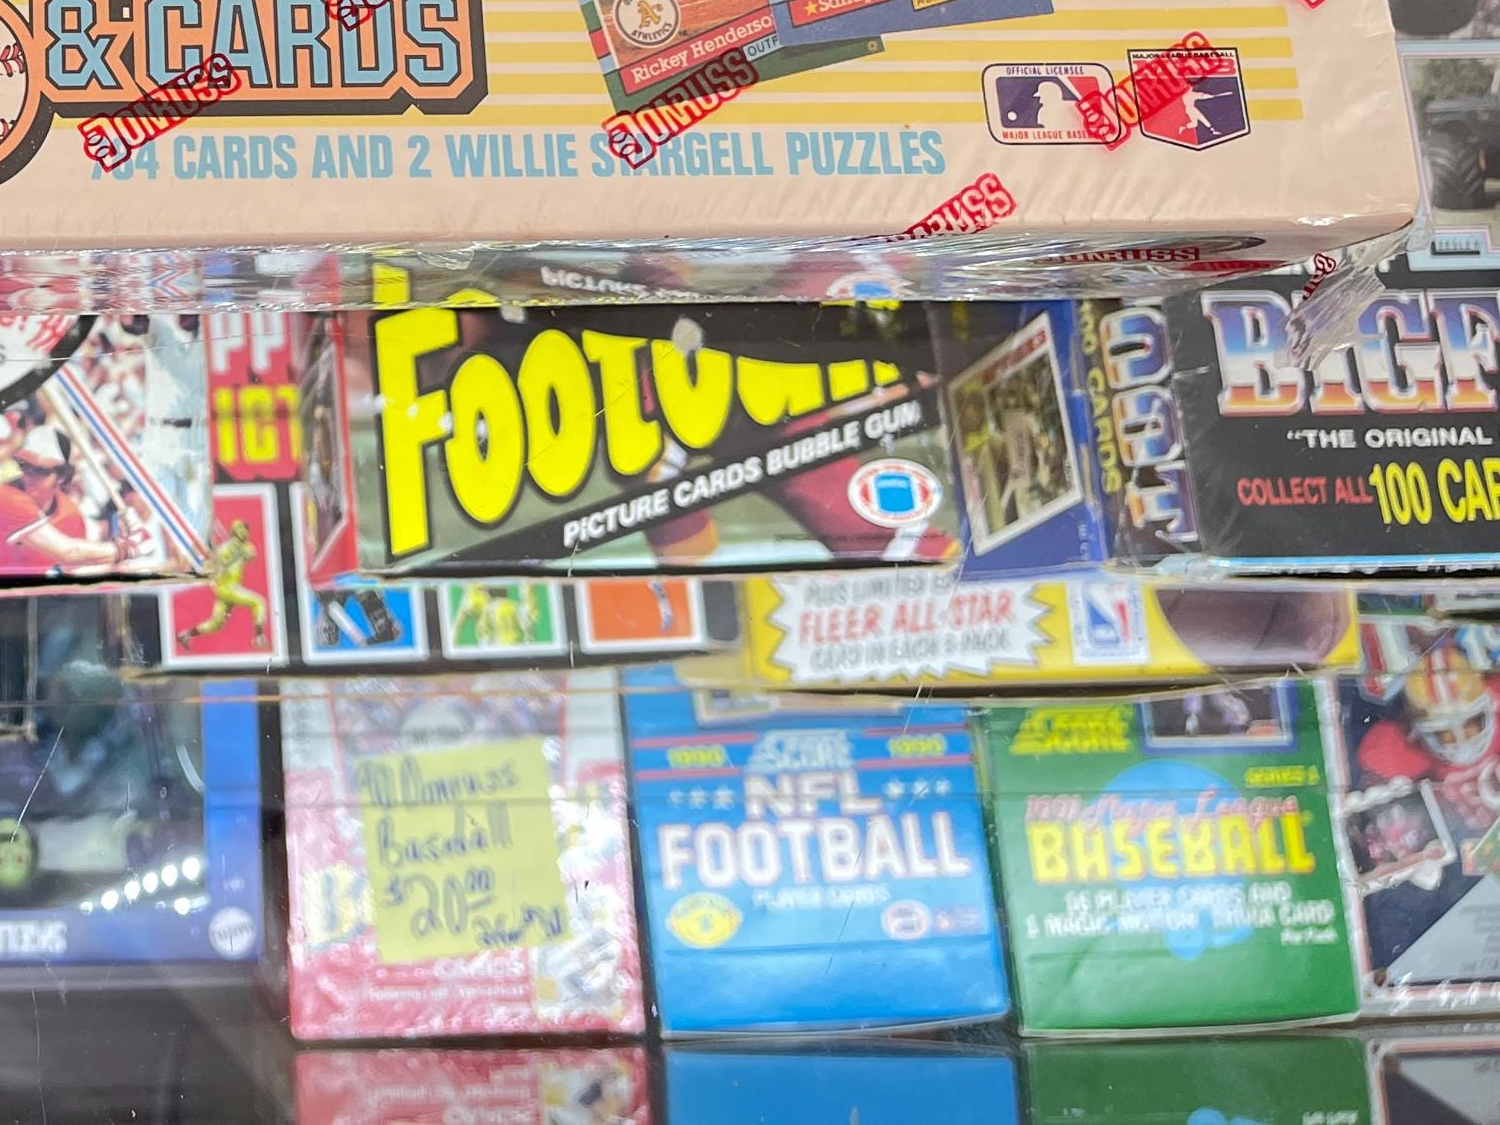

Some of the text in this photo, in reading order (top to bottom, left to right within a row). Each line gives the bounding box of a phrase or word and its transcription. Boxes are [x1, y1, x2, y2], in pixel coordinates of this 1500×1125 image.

[631, 21, 673, 43] ATHLETICS
[631, 14, 775, 84] Rickey Henderso
[1005, 66, 1085, 76] OFFICIAL LICENSEE
[77, 53, 241, 173] DONRUSS
[602, 47, 759, 169] DONRUSS
[1002, 130, 1028, 140] MAJOR
[1031, 130, 1064, 140] LEAGUE
[173, 134, 298, 180] CARDS
[311, 134, 395, 179] AND
[408, 134, 431, 178] 2
[444, 132, 578, 178] WILLIE
[786, 130, 947, 176] PUZZLES
[1365, 426, 1494, 448] ORIGINAL
[563, 398, 922, 547] PICTURE CARDS BUBBLE GUM
[1237, 476, 1329, 507] COLLECT
[1334, 476, 1373, 505] ALL
[1368, 461, 1434, 525] 100
[800, 605, 882, 644] FLEER
[744, 770, 884, 822] NFL
[658, 811, 970, 891] FOOTBALL
[1027, 813, 1316, 884] BASEBALL
